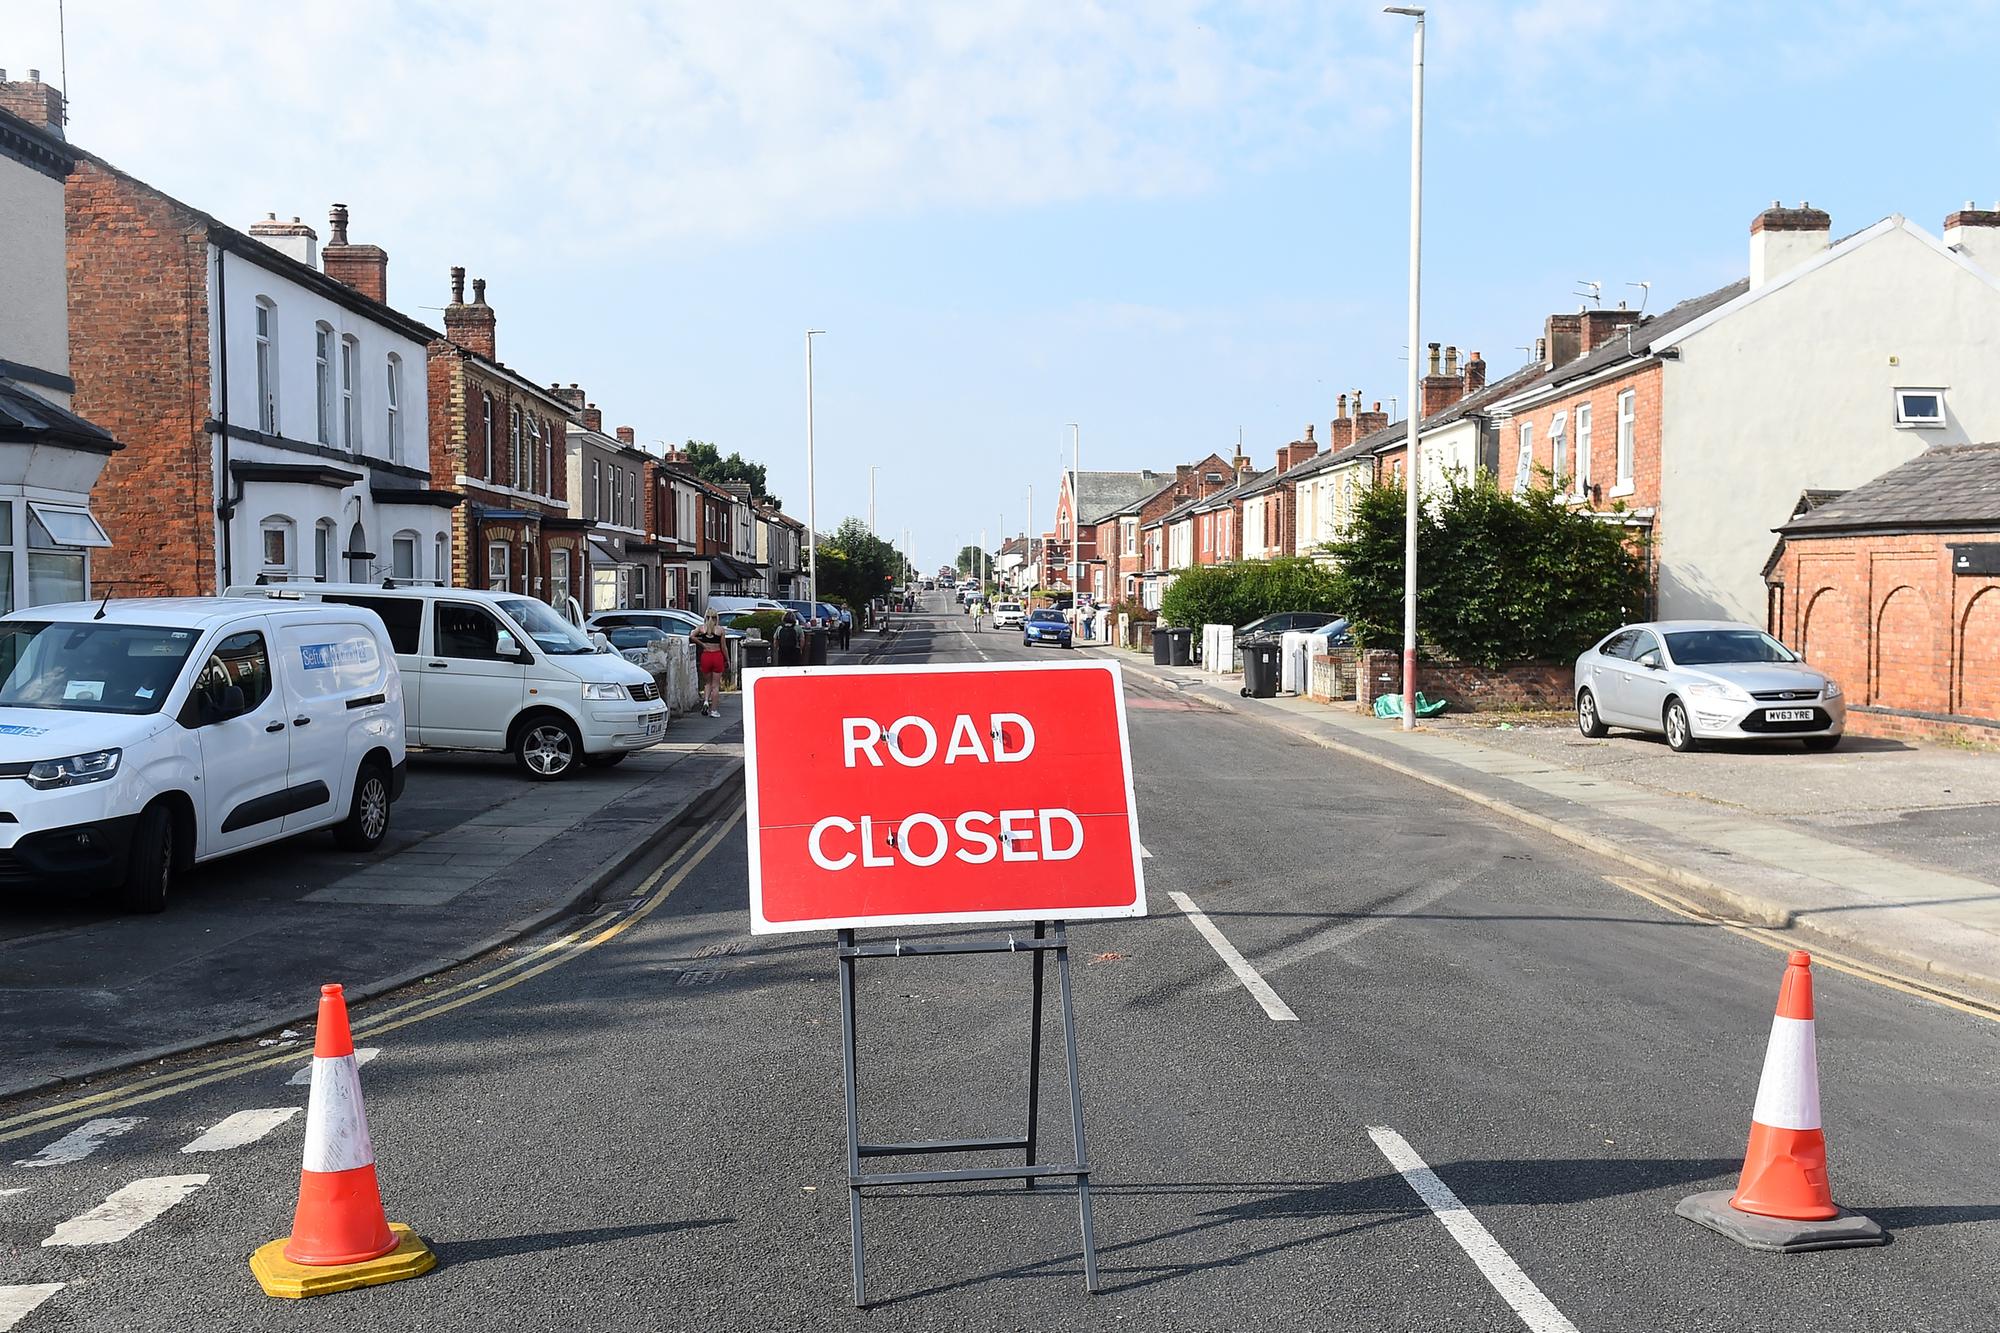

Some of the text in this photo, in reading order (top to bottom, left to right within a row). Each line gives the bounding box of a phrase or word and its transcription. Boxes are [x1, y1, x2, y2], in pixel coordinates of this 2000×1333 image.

[842, 713, 1036, 768] ROAD
[1769, 710, 1811, 720] MV63 YRE
[808, 808, 1084, 871] CLOSED
